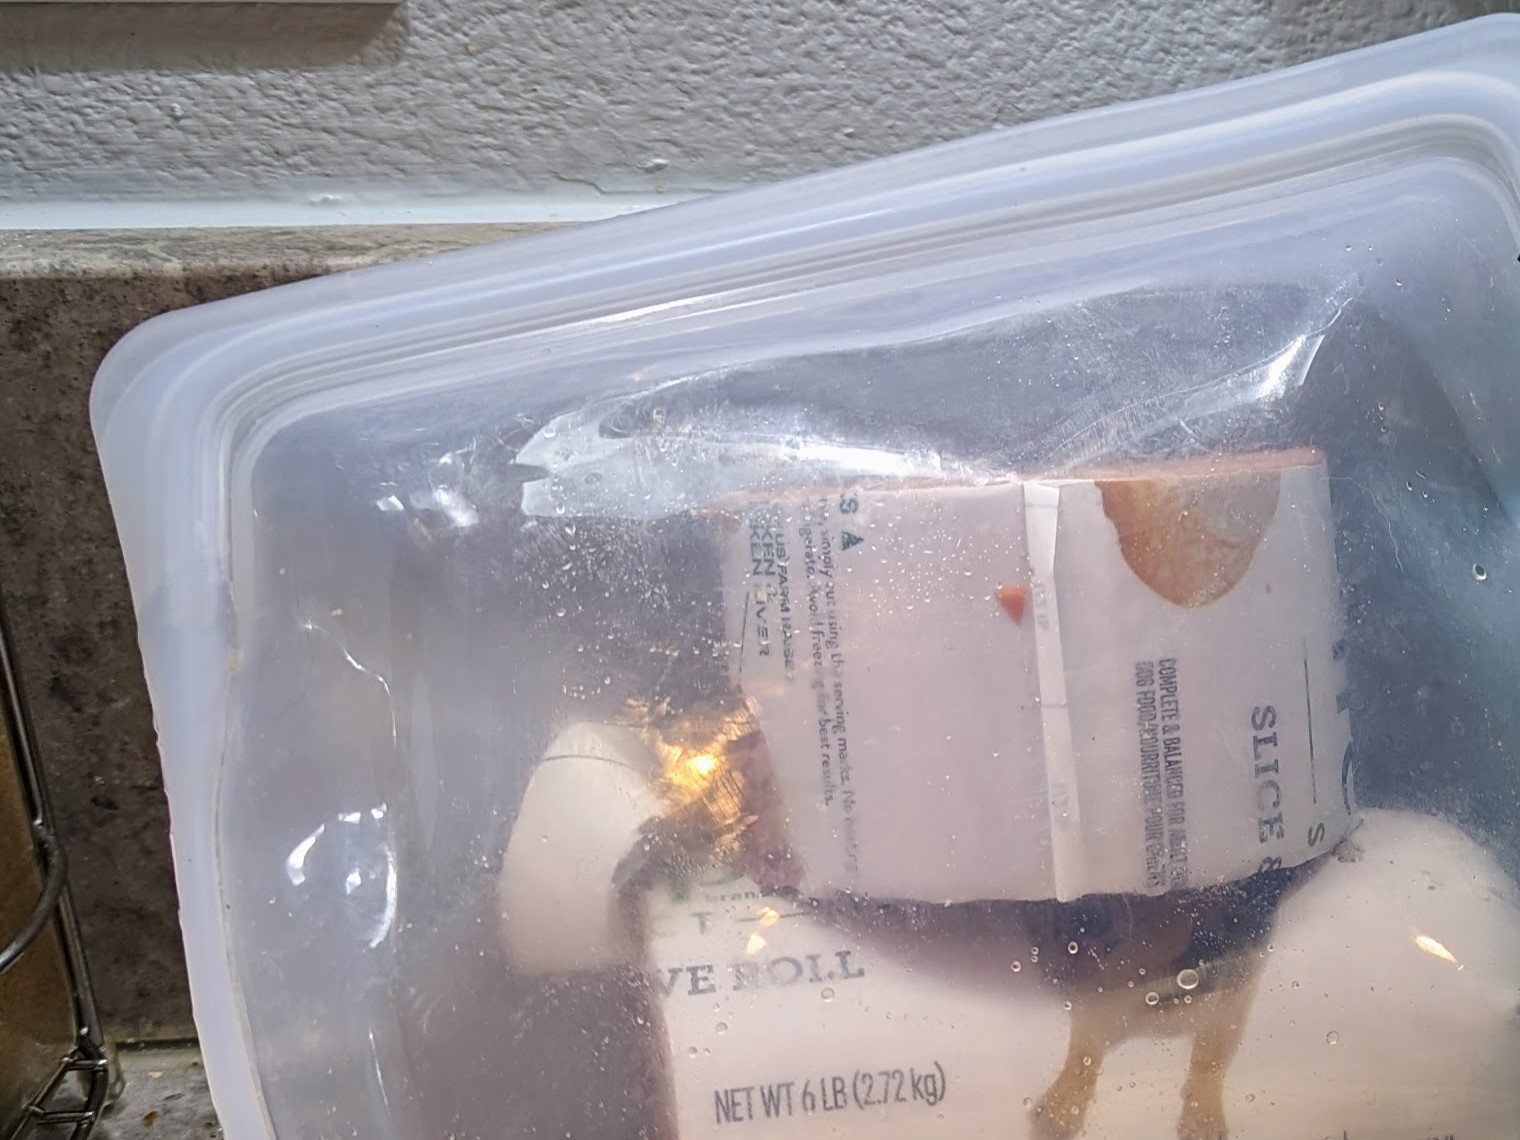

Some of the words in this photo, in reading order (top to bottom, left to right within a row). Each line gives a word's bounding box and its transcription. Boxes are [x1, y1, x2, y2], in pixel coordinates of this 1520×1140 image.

[832, 681, 850, 734] serving
[1158, 658, 1180, 721] COMPLETE
[1163, 736, 1184, 798] BALANCED
[1251, 704, 1285, 843] SLICE
[732, 950, 866, 992] ROLL
[714, 1086, 755, 1124] NET
[760, 1081, 795, 1119] WT
[801, 1079, 816, 1113] 6
[820, 1075, 848, 1112] LB
[852, 1068, 907, 1111] (2.72
[910, 1060, 947, 1106] kg)
